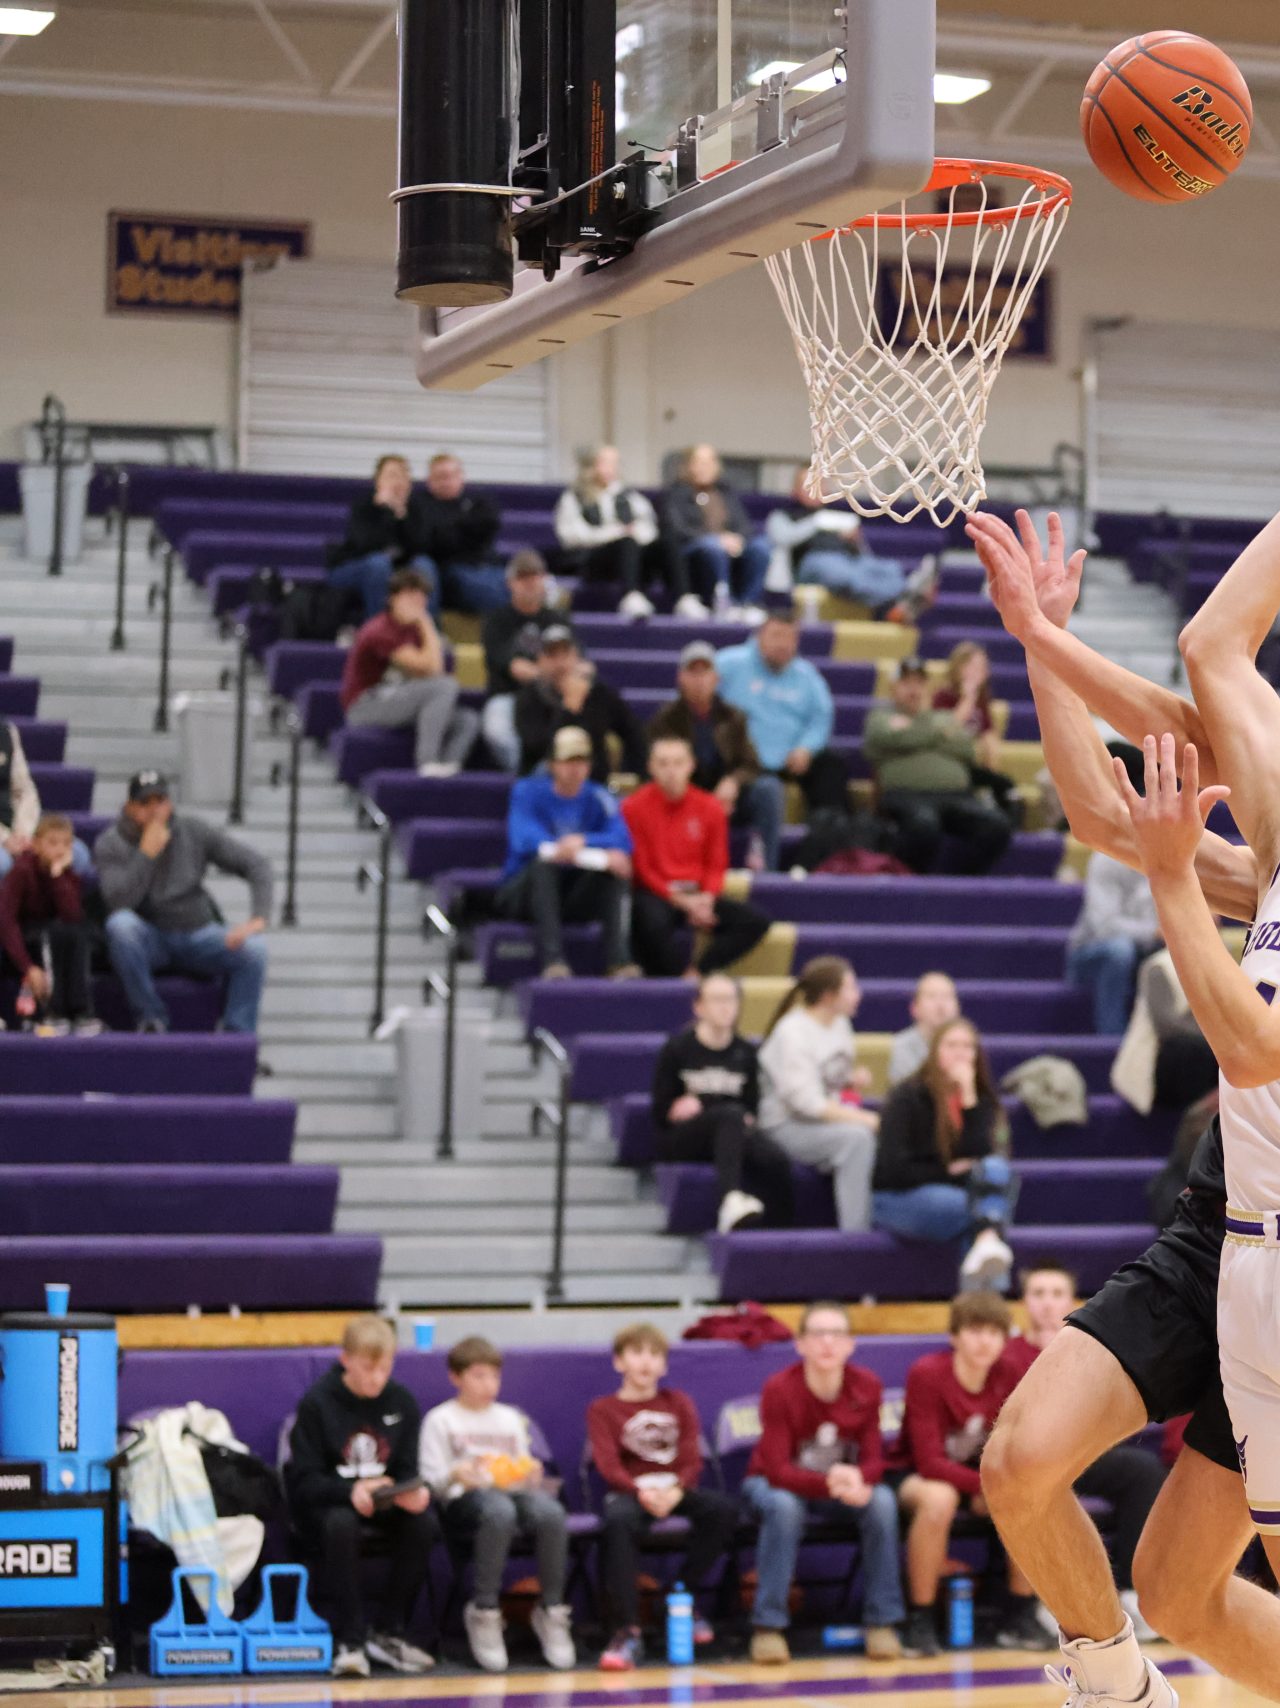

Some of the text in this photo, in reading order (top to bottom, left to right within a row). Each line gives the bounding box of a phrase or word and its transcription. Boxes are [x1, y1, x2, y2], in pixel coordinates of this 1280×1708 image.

[1133, 123, 1193, 187] ELITE
[1170, 85, 1245, 159] Baden
[59, 1337, 78, 1450] POWERADE
[0, 1543, 72, 1574] ADE
